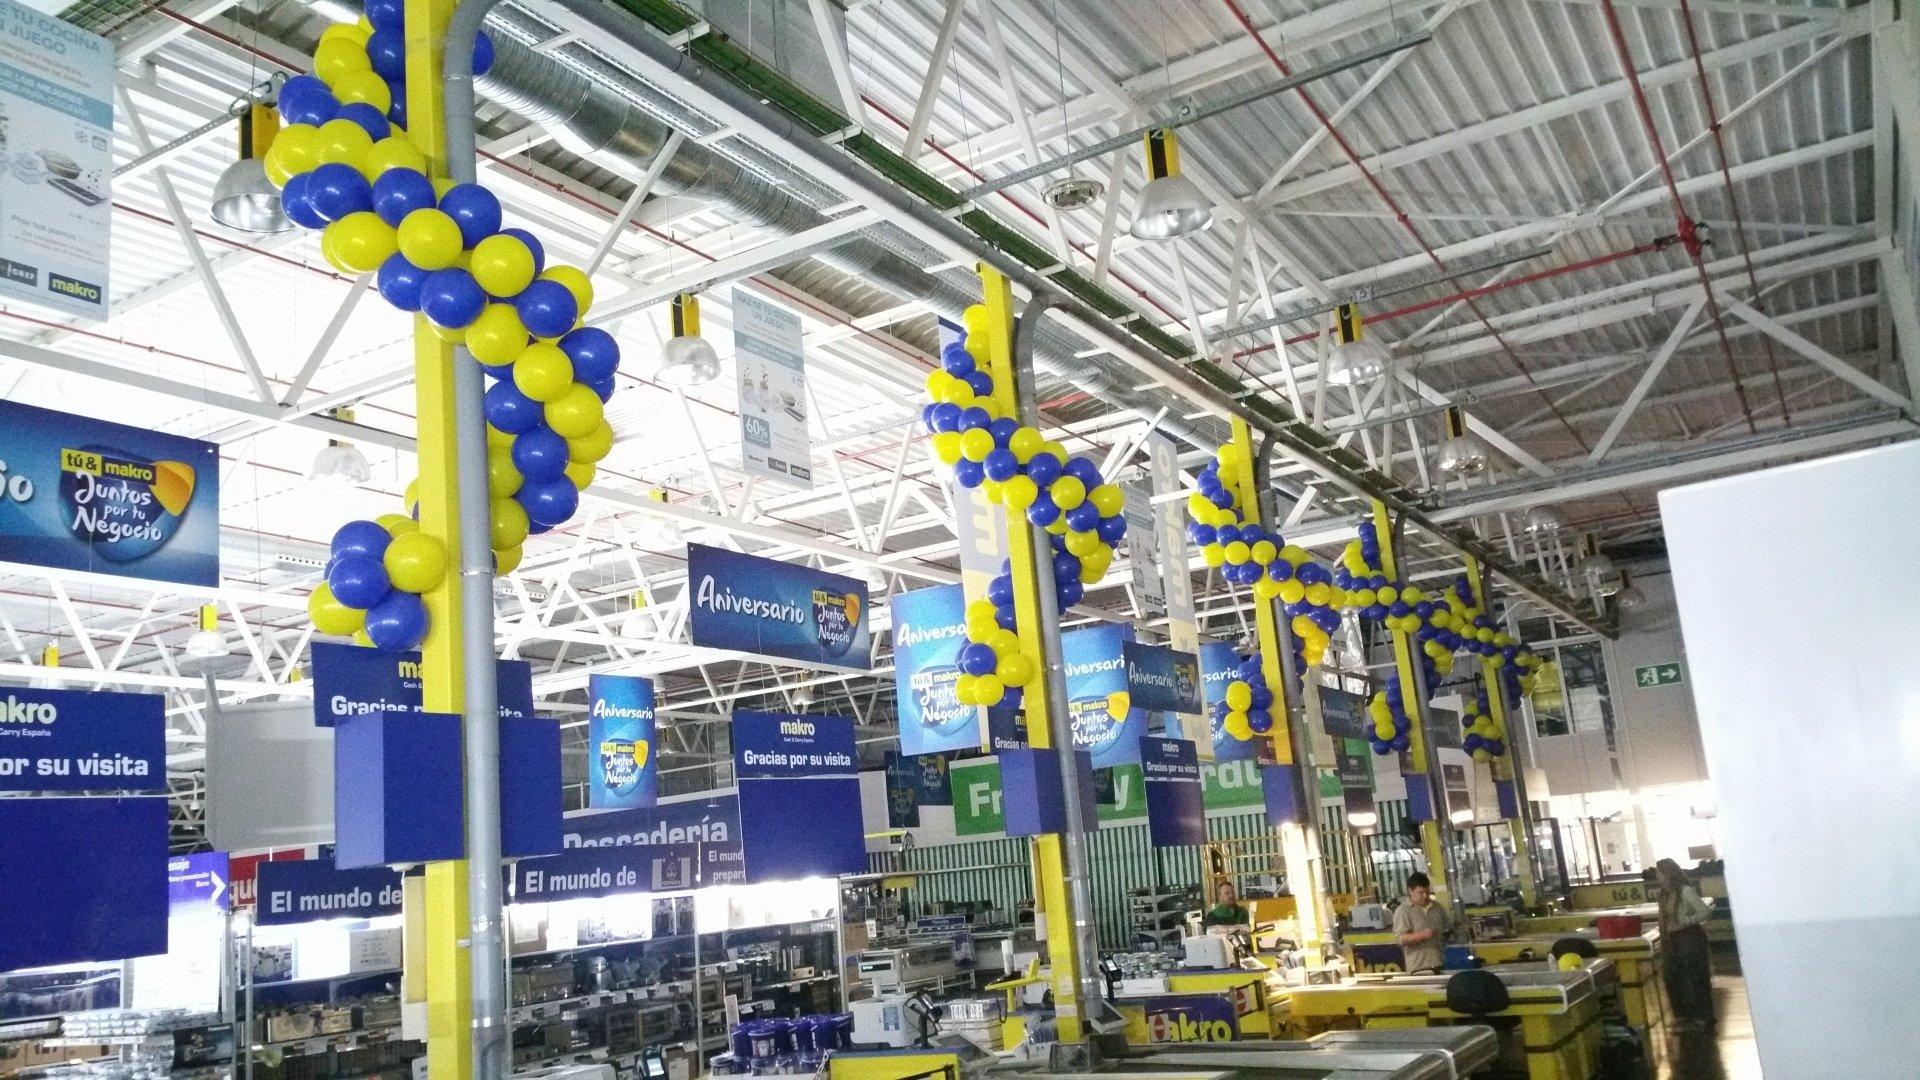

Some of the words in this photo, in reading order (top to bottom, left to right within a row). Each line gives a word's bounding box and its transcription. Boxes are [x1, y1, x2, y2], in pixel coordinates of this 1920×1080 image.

[9, 26, 66, 54] JUEGO
[11, 6, 33, 25] TU
[38, 18, 101, 54] COCINA
[52, 278, 98, 299] makro
[746, 417, 768, 439] 60%
[66, 453, 83, 468] tú
[85, 457, 97, 470] &
[105, 462, 153, 481] makro
[74, 470, 151, 505] Juntos
[104, 504, 129, 520] por
[132, 506, 146, 520] tu
[72, 506, 162, 543] Negocio
[697, 574, 805, 625] Aniversario
[818, 603, 846, 623] Juntos
[818, 623, 850, 646] Negocio
[1128, 660, 1173, 687] Aniversario
[920, 683, 957, 706] Junto
[593, 698, 654, 720] Aniversario
[920, 703, 971, 725] Negocio
[1082, 700, 1108, 712] makro
[780, 719, 816, 736] makro
[1070, 711, 1109, 732] Juntos
[22, 728, 51, 738] España
[994, 736, 1020, 750] Gracias
[1072, 729, 1117, 747] Negocio
[37, 758, 70, 776] su
[77, 752, 149, 776] visita
[605, 753, 634, 770] Juntos
[744, 750, 788, 765] Gracias
[790, 754, 808, 769] por
[810, 755, 823, 766] su
[824, 752, 851, 767] visita
[1146, 761, 1168, 772] Gracias
[604, 770, 637, 788] Negocio
[1113, 774, 1130, 812] y
[708, 850, 718, 862] El
[525, 871, 544, 894] El
[551, 867, 611, 891] mundo
[616, 865, 637, 886] de
[271, 891, 292, 913] El
[300, 886, 372, 911] mundo
[379, 884, 402, 905] de
[1612, 886, 1628, 901] tú
[1169, 1012, 1232, 1043] akro
